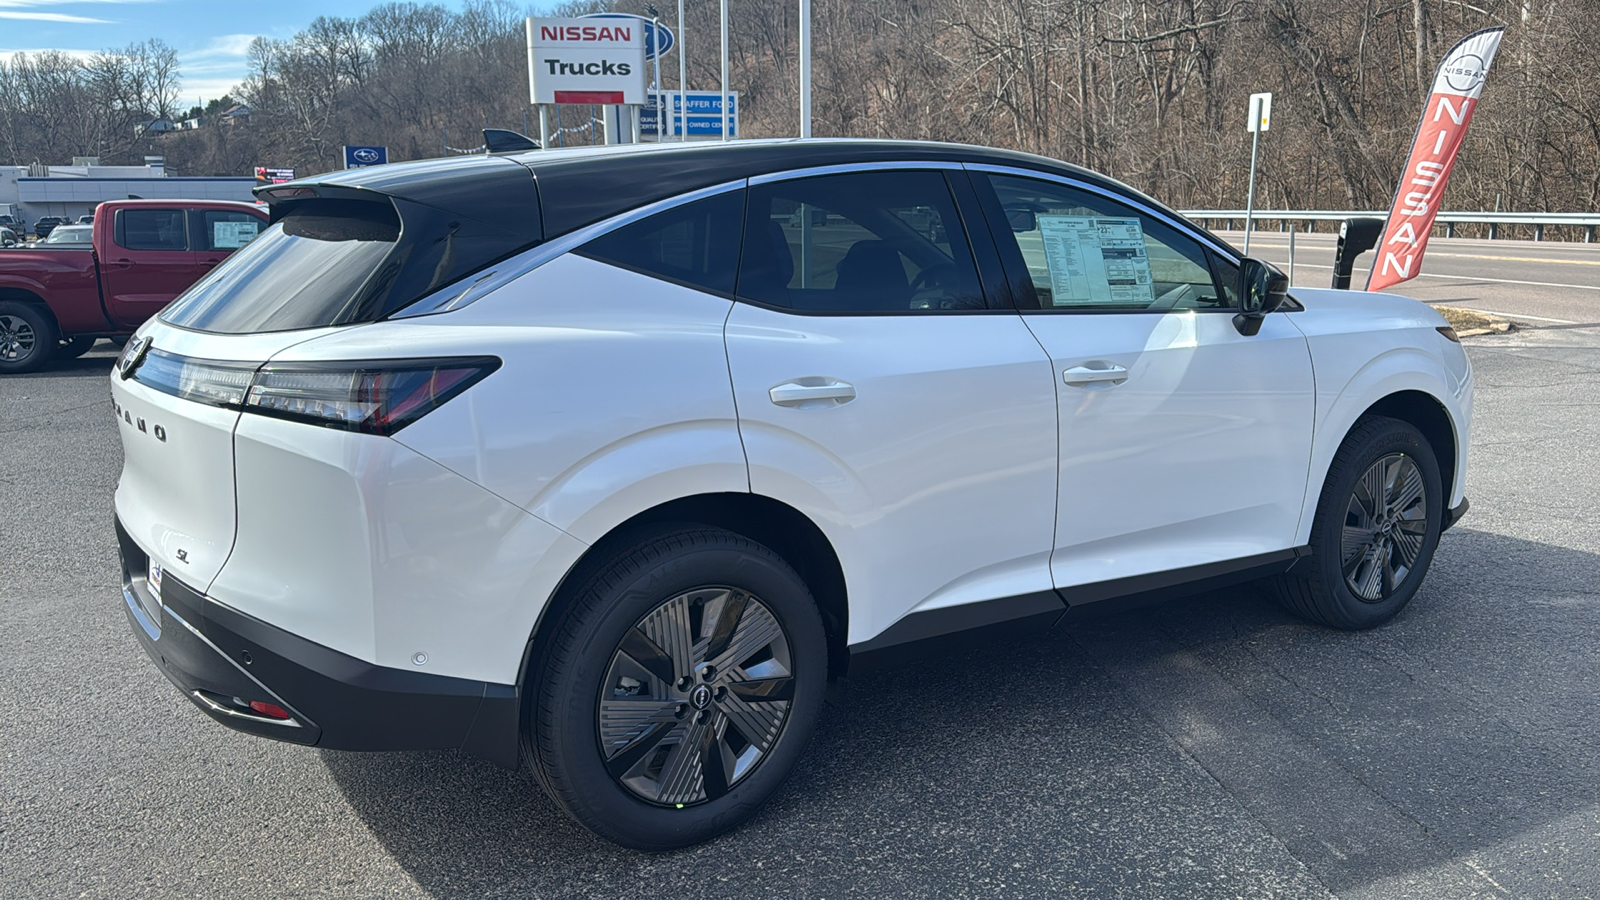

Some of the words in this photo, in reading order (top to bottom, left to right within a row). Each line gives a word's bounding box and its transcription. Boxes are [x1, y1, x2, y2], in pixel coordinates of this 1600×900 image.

[541, 26, 631, 42] NISSAN
[544, 59, 631, 76] Trucks
[1444, 67, 1486, 79] NISSAN
[674, 100, 710, 108] SAFFER
[712, 100, 734, 108] FOD
[1381, 97, 1469, 279] NISSAN
[175, 548, 190, 565] SL
